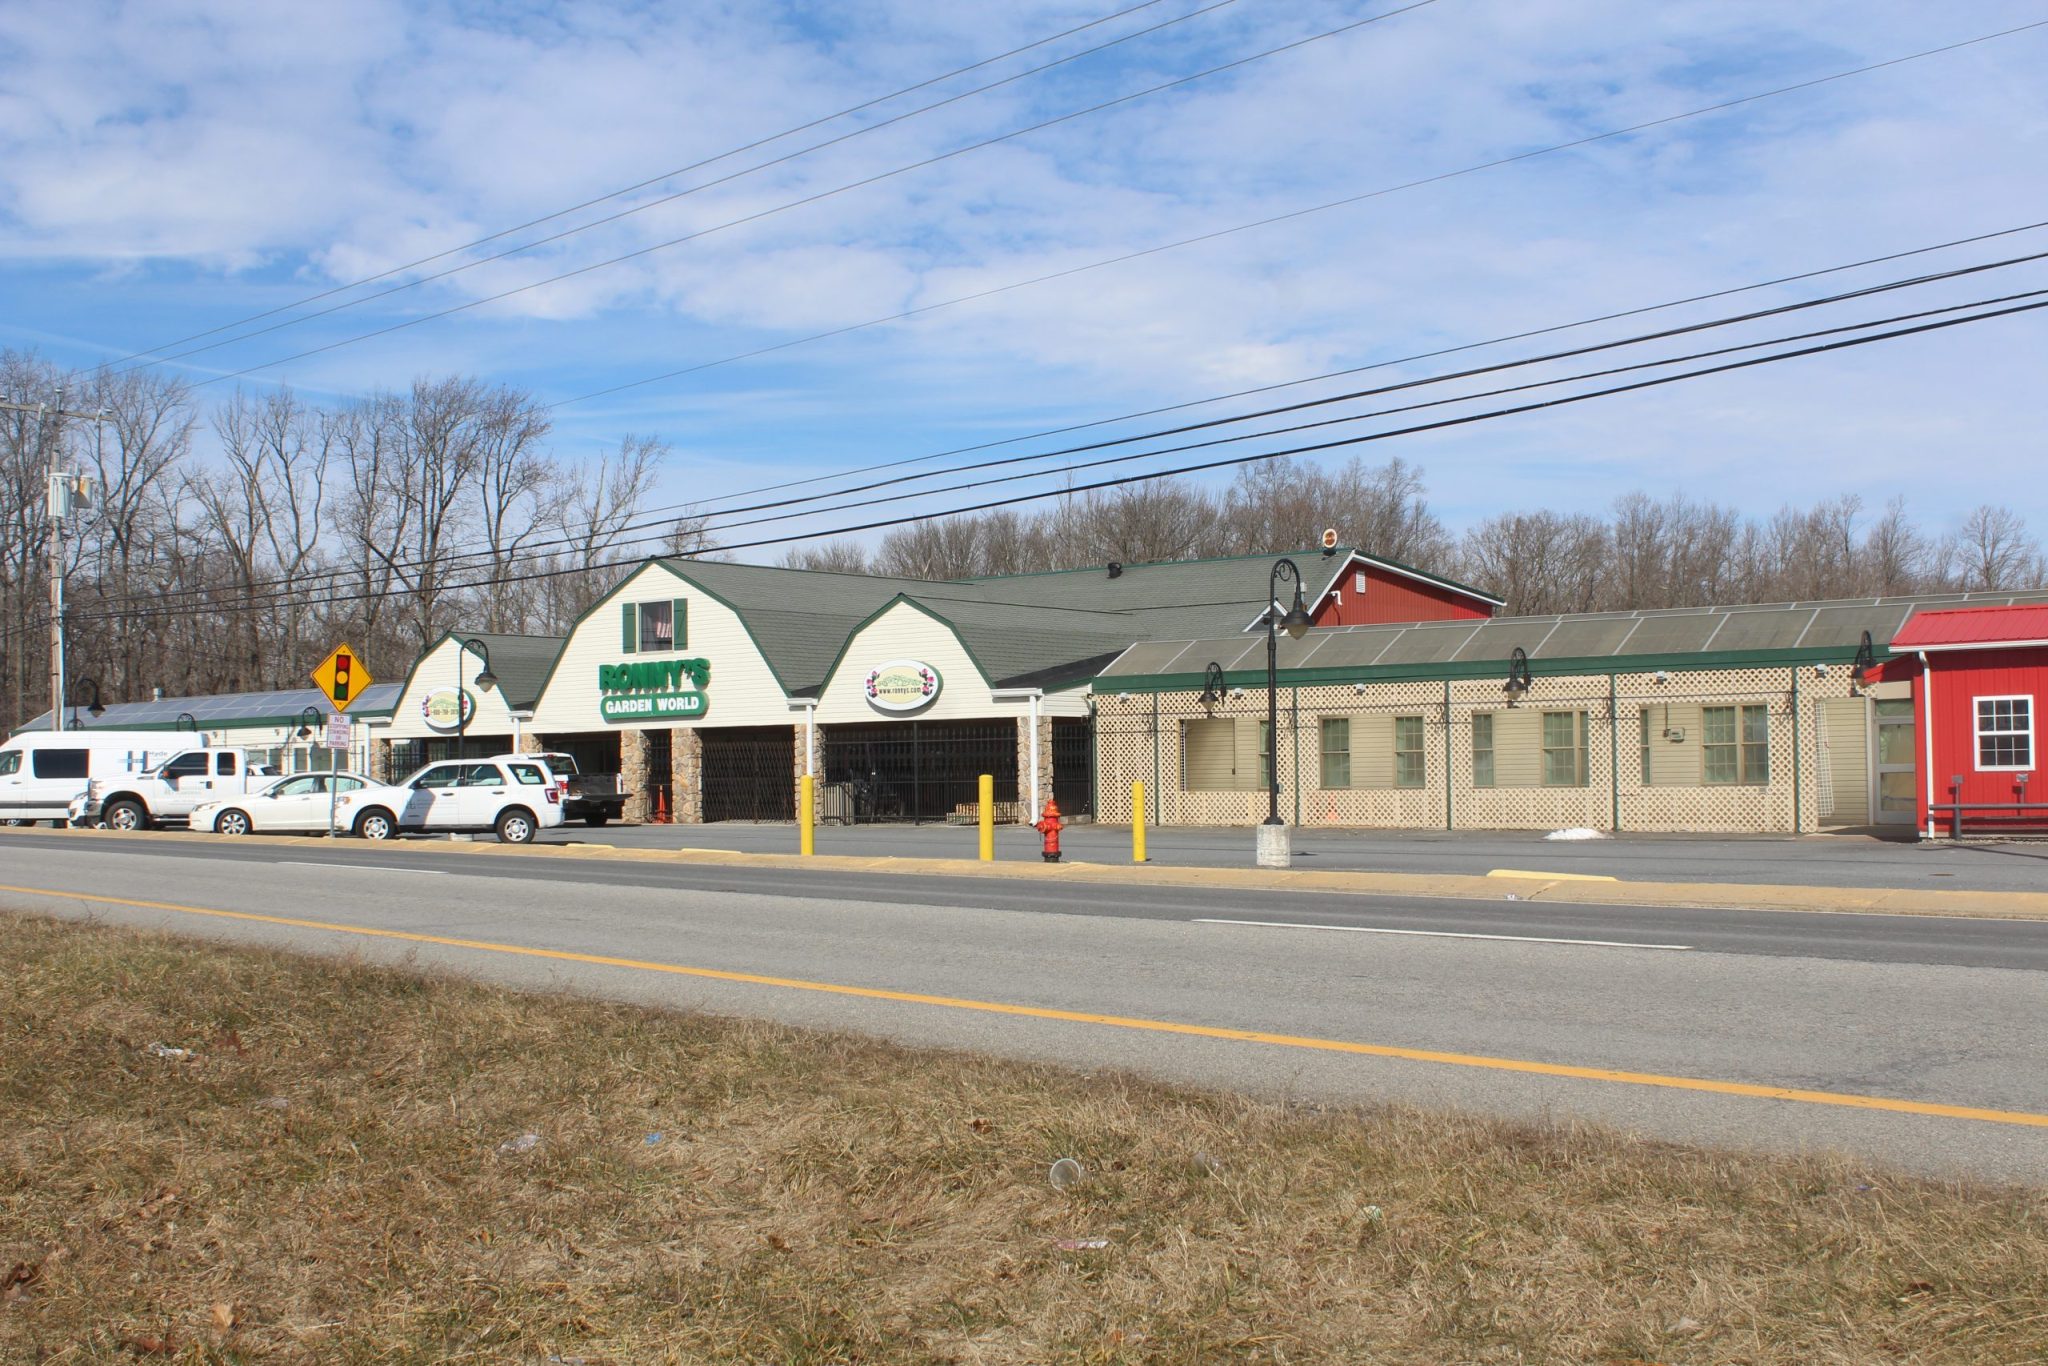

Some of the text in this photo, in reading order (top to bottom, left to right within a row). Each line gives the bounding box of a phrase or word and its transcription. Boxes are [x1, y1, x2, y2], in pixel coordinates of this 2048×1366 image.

[599, 658, 711, 691] RONNY'S
[605, 696, 700, 714] GARDEN WORLD
[334, 716, 345, 724] NO
